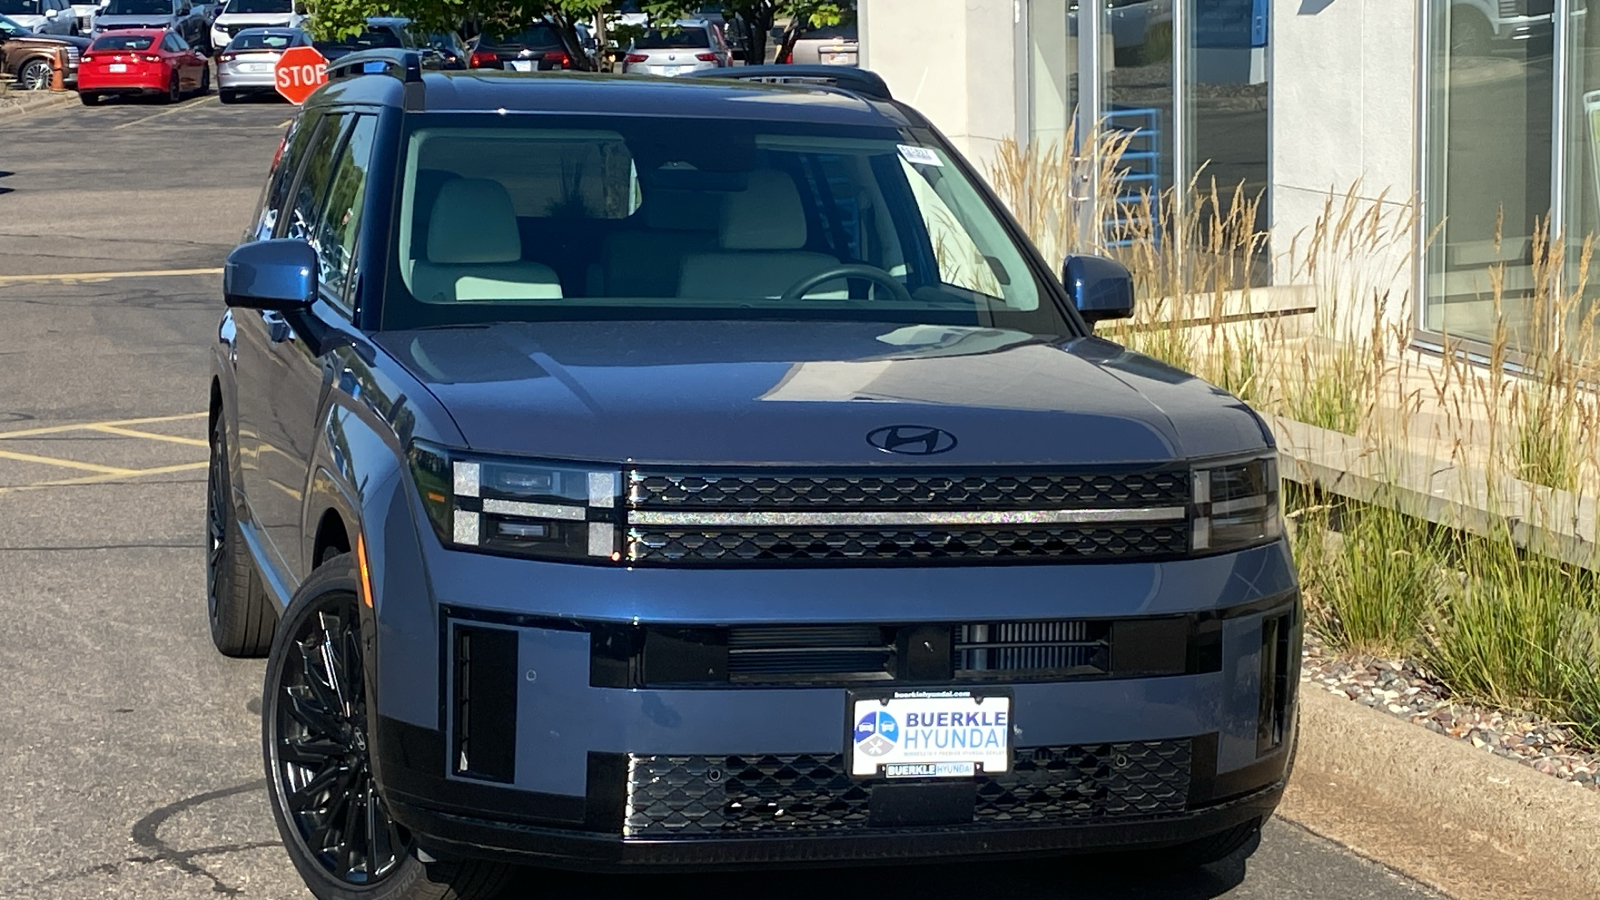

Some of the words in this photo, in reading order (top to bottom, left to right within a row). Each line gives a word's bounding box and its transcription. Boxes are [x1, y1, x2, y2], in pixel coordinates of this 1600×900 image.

[278, 63, 327, 87] STOP
[906, 712, 1007, 727] BUERKLE
[904, 728, 1006, 749] HYUNDAI
[887, 764, 936, 776] BUERKLE
[936, 763, 973, 775] HYUNDAI
